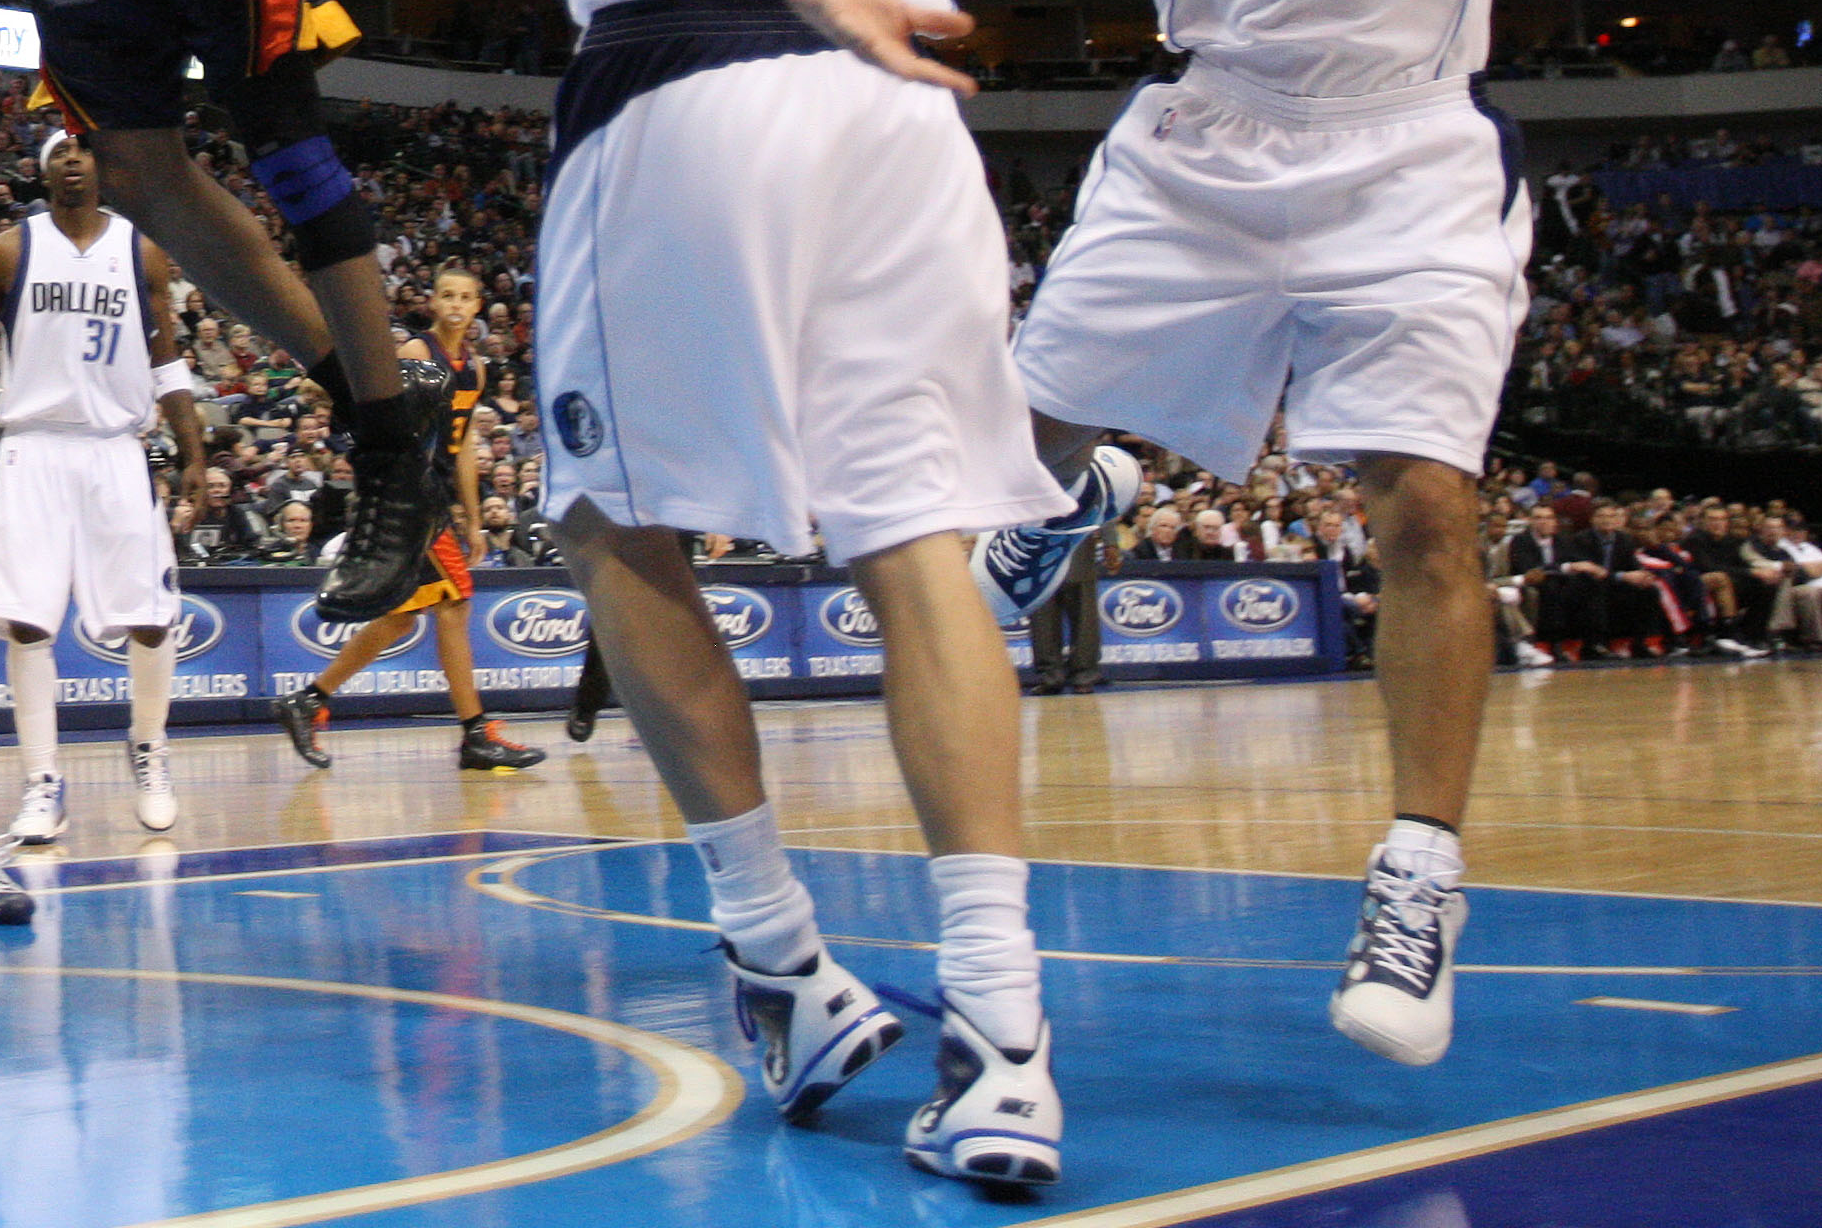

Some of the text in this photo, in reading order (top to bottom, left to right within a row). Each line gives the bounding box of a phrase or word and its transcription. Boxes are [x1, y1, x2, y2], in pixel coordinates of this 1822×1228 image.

[31, 281, 129, 318] DALLAS
[82, 319, 122, 366] 31
[509, 597, 586, 643] Ford
[1114, 587, 1167, 624] Ford
[1235, 584, 1284, 622] Ford
[55, 677, 115, 703] TEXAS
[377, 670, 451, 694] DEALERS
[472, 667, 521, 691] TEXAS
[522, 666, 562, 689] FORD
